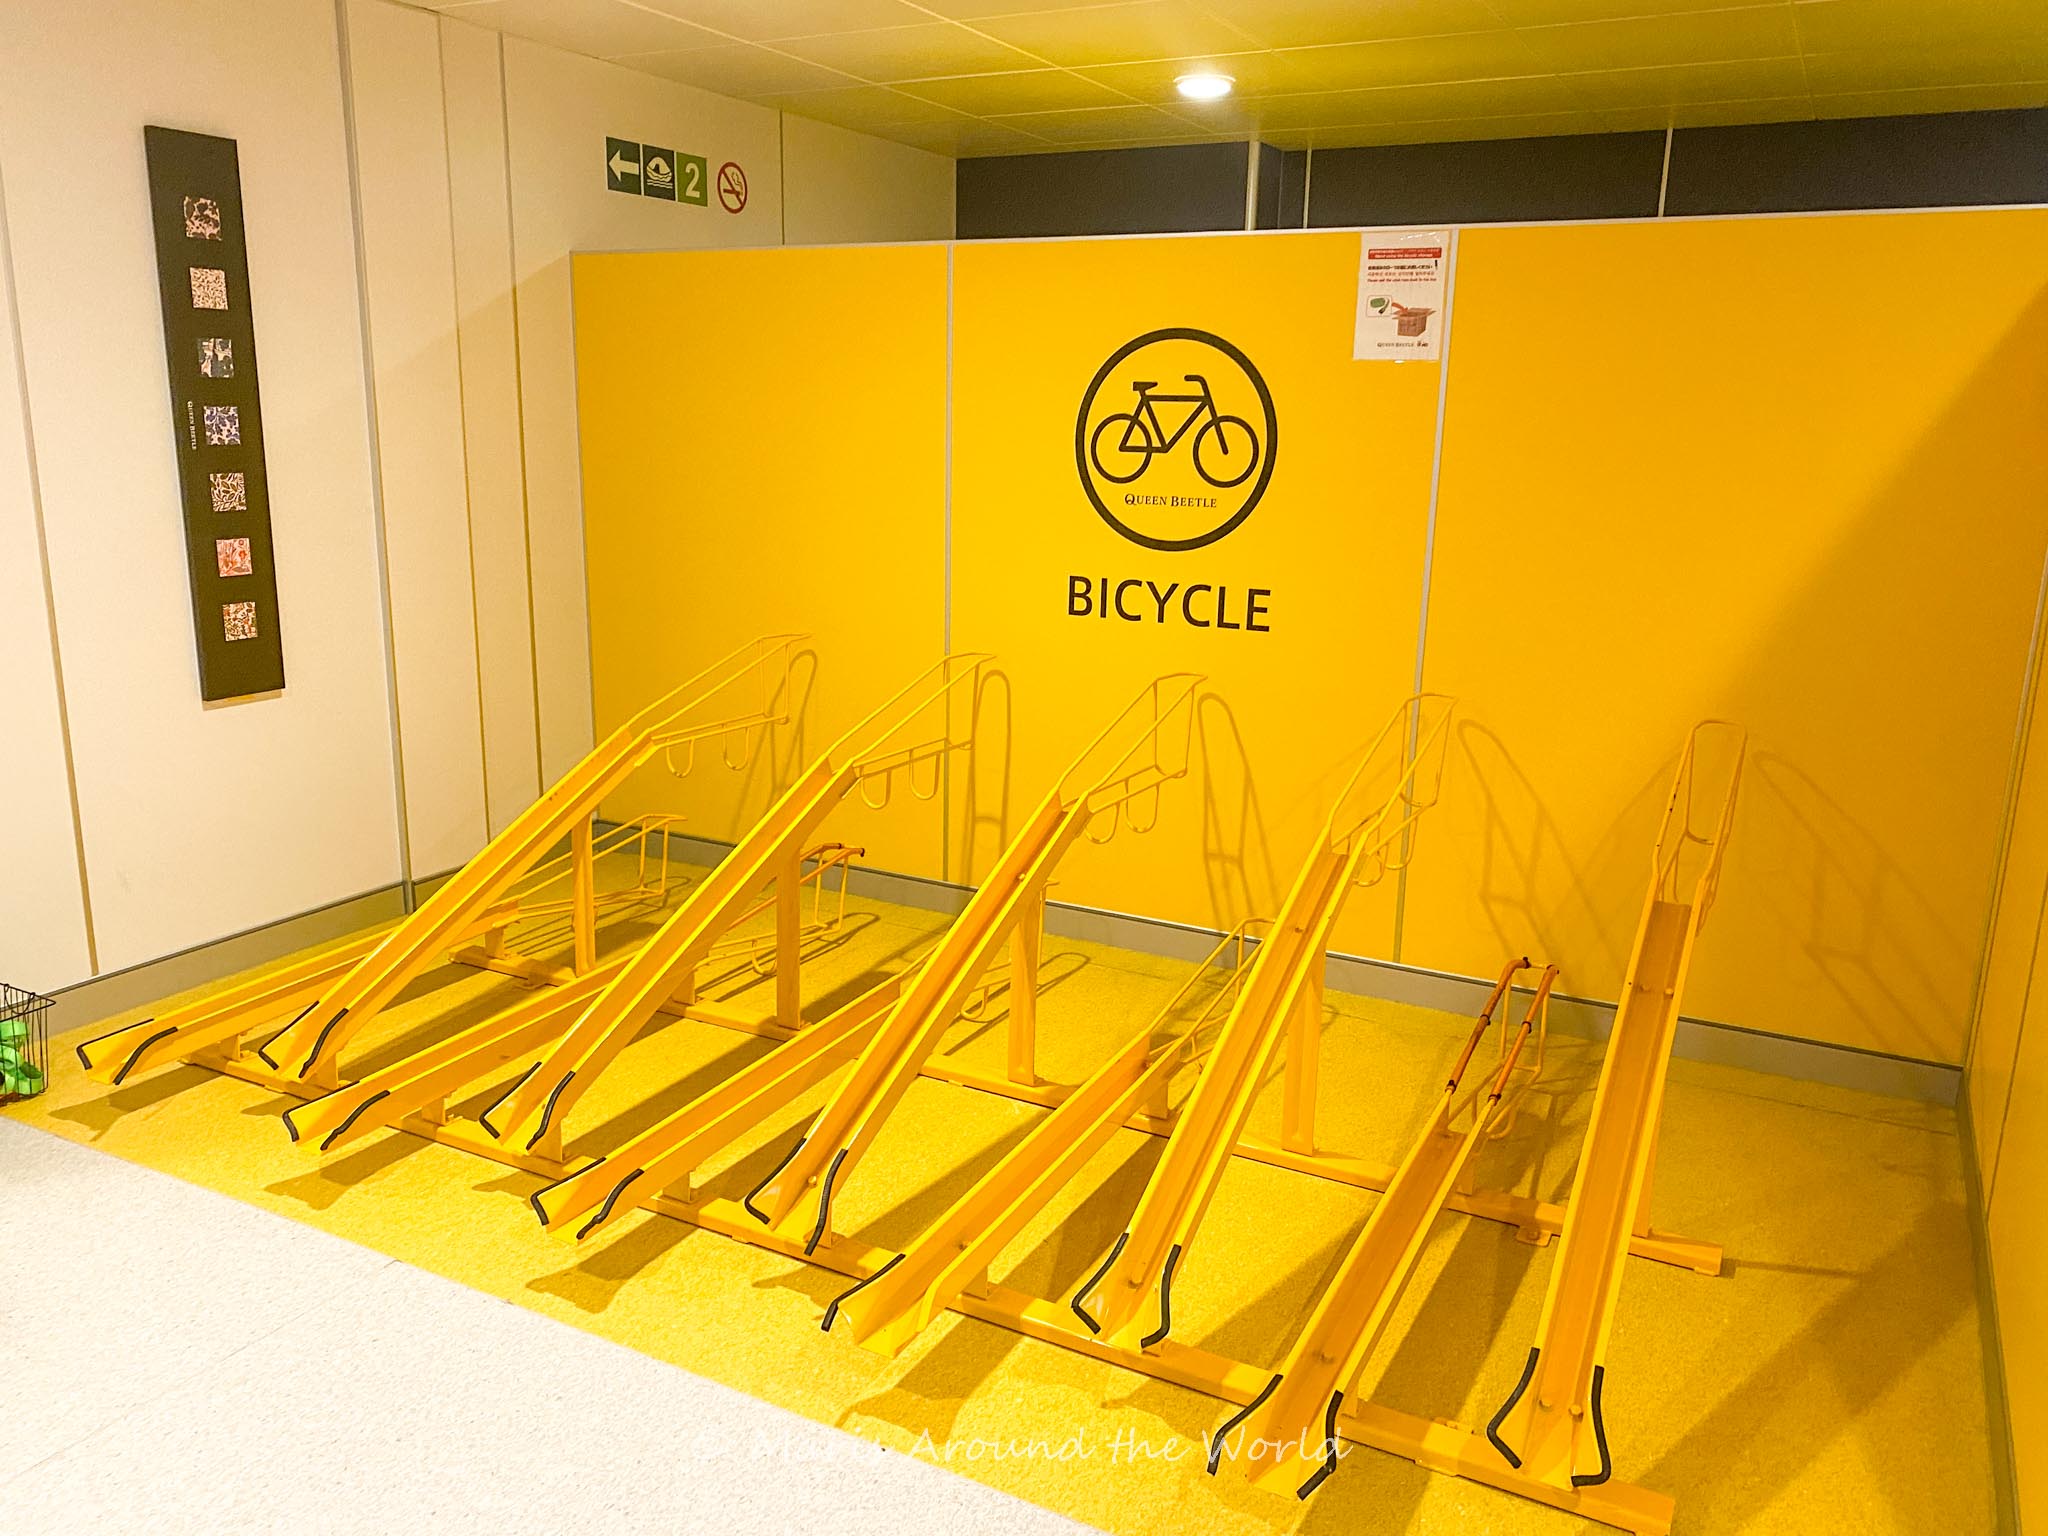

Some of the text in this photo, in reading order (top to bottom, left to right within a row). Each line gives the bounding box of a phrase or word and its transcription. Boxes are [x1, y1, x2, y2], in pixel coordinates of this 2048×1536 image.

[685, 162, 701, 199] 2
[1124, 493, 1217, 508] QUEEN BEETLE
[1067, 575, 1272, 633] BICYCLE
